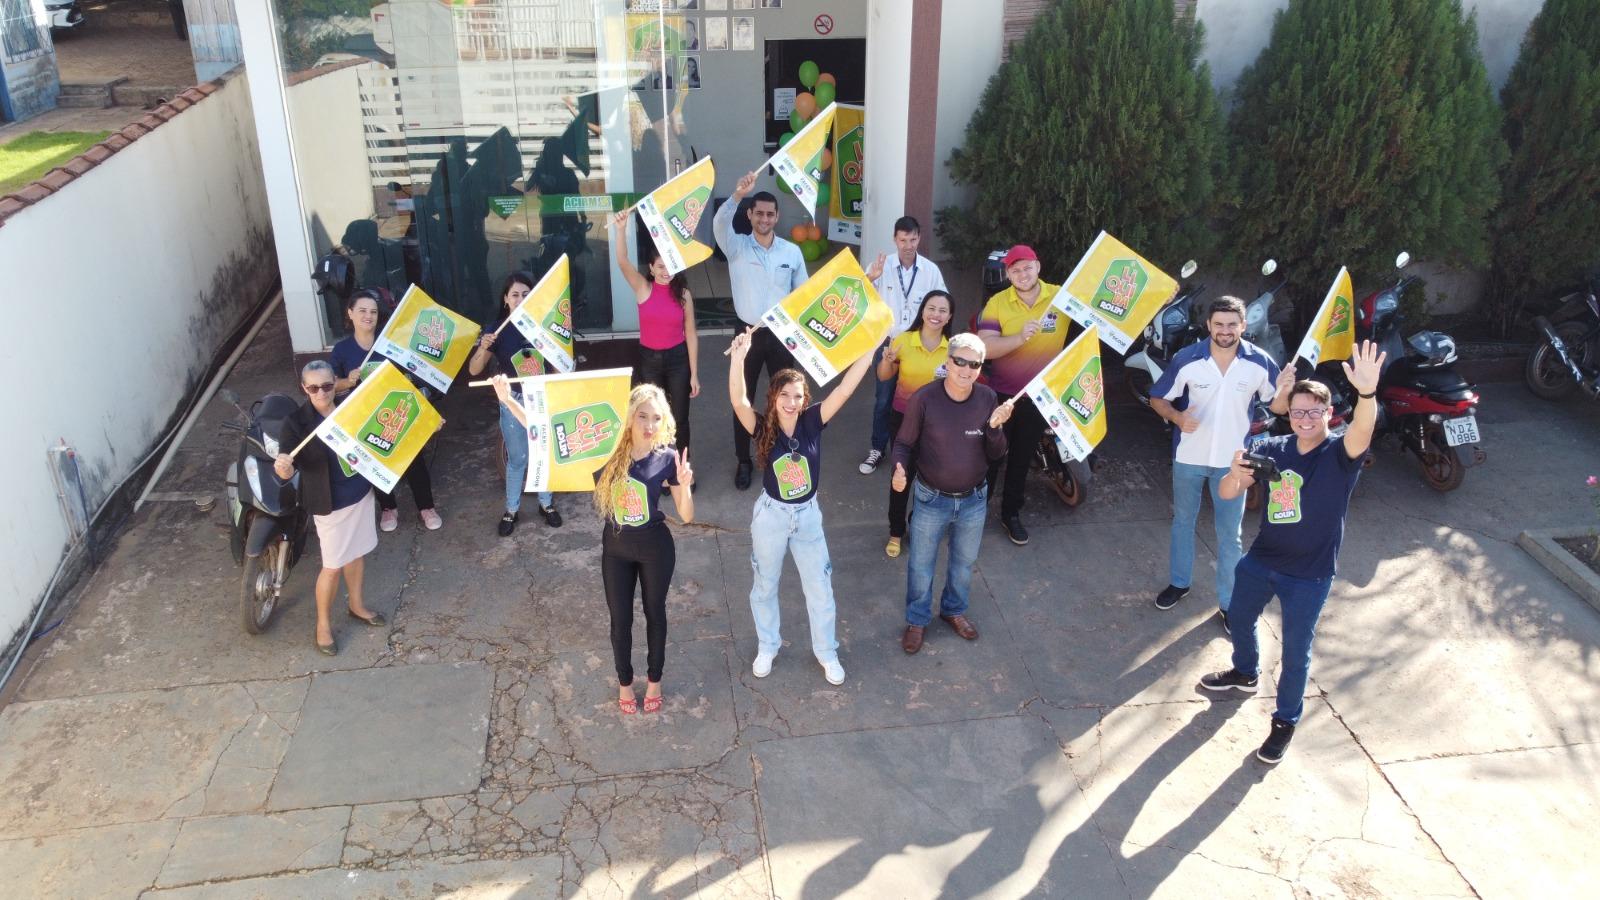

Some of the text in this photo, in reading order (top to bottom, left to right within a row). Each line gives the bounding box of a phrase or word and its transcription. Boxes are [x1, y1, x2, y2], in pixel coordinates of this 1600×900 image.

[670, 216, 690, 238] ROLIM
[1099, 301, 1125, 315] ROLIM
[808, 319, 836, 341] ROLIM
[418, 344, 441, 357] ROLIM
[1068, 397, 1091, 418] ROLIM
[1449, 422, 1473, 436] NDZ
[366, 434, 393, 450] ROLIM
[555, 424, 569, 458] ROLIM
[1451, 432, 1477, 445] 1886
[1273, 511, 1295, 519] ROLIM
